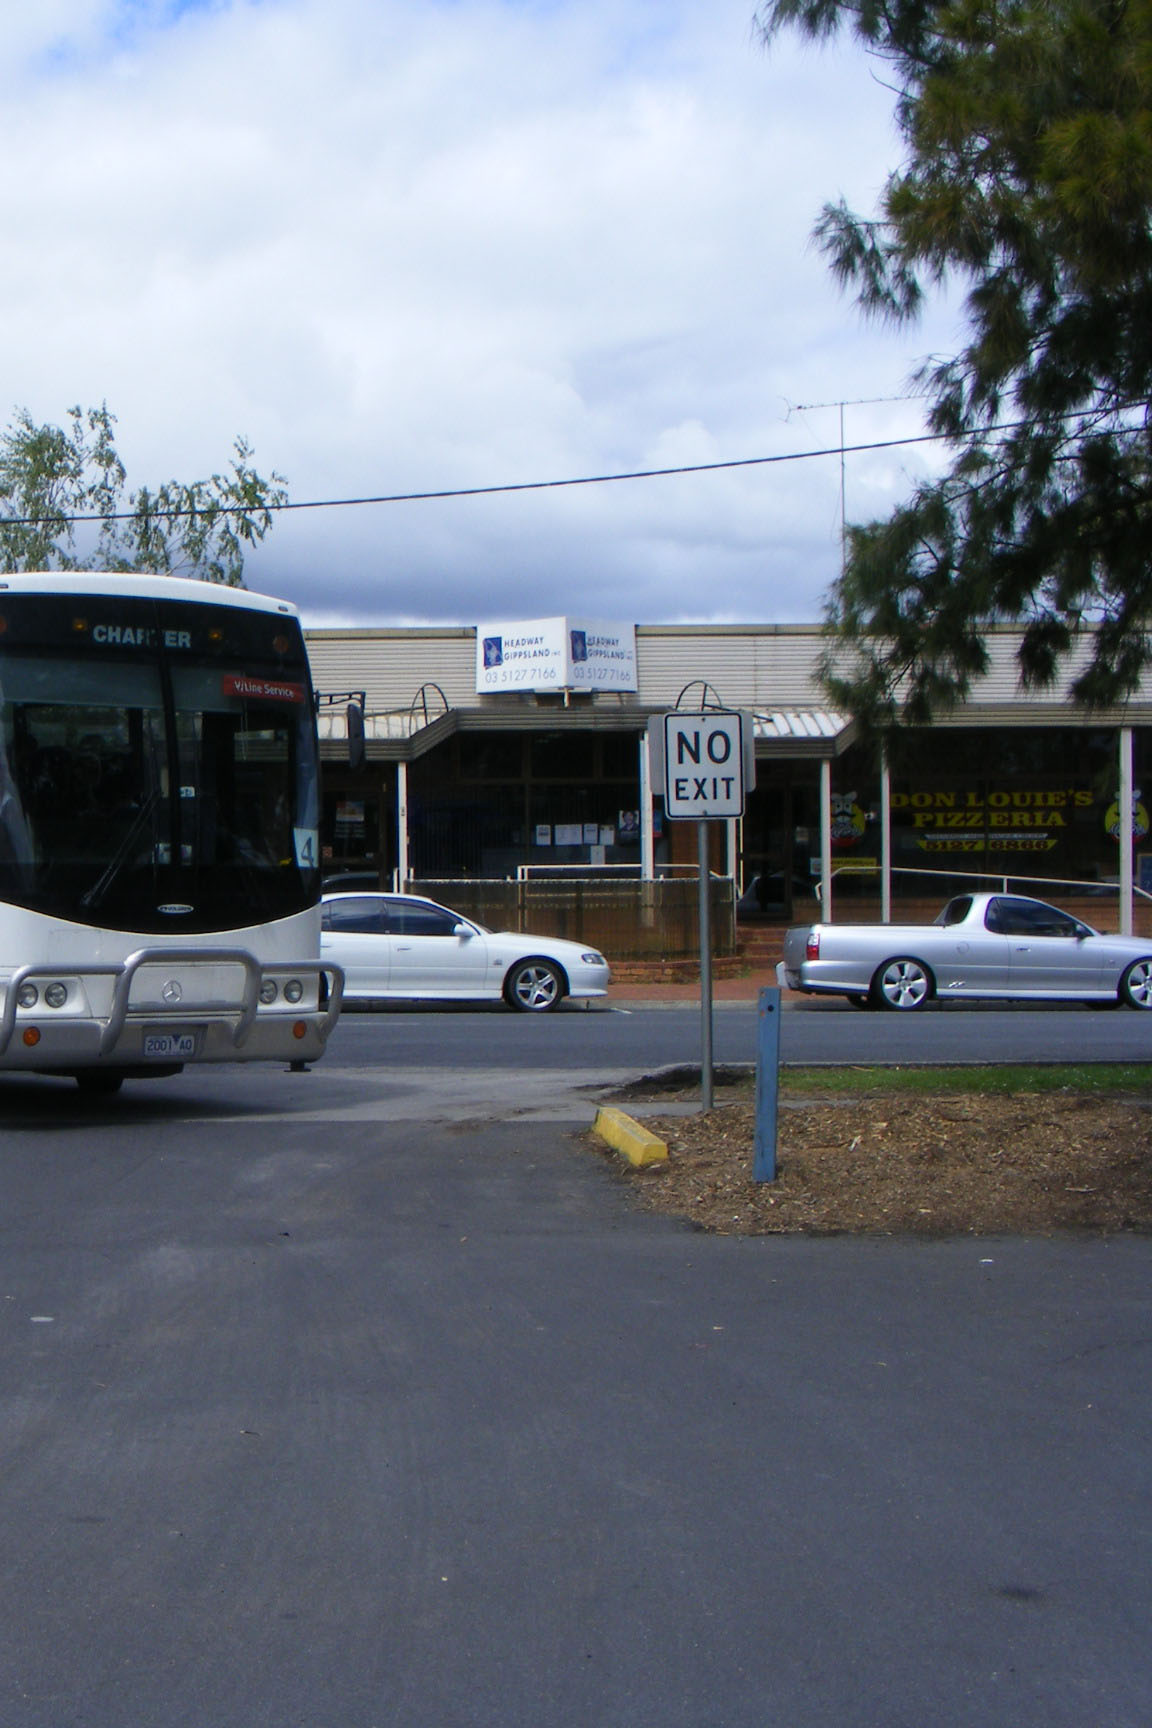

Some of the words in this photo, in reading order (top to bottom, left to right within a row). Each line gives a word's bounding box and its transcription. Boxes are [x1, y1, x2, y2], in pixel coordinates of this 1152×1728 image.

[504, 636, 544, 648] HEADWAY
[504, 648, 550, 661] GIPPSLAND
[588, 648, 624, 660] GIPPSLAND
[485, 671, 498, 684] 03
[501, 669, 527, 682] 5127
[530, 667, 557, 680] 7166
[677, 730, 731, 764] NO
[675, 777, 735, 800] EXIT
[890, 793, 956, 808] DON
[912, 812, 1067, 827] PIZZERIA
[301, 837, 314, 867] 4
